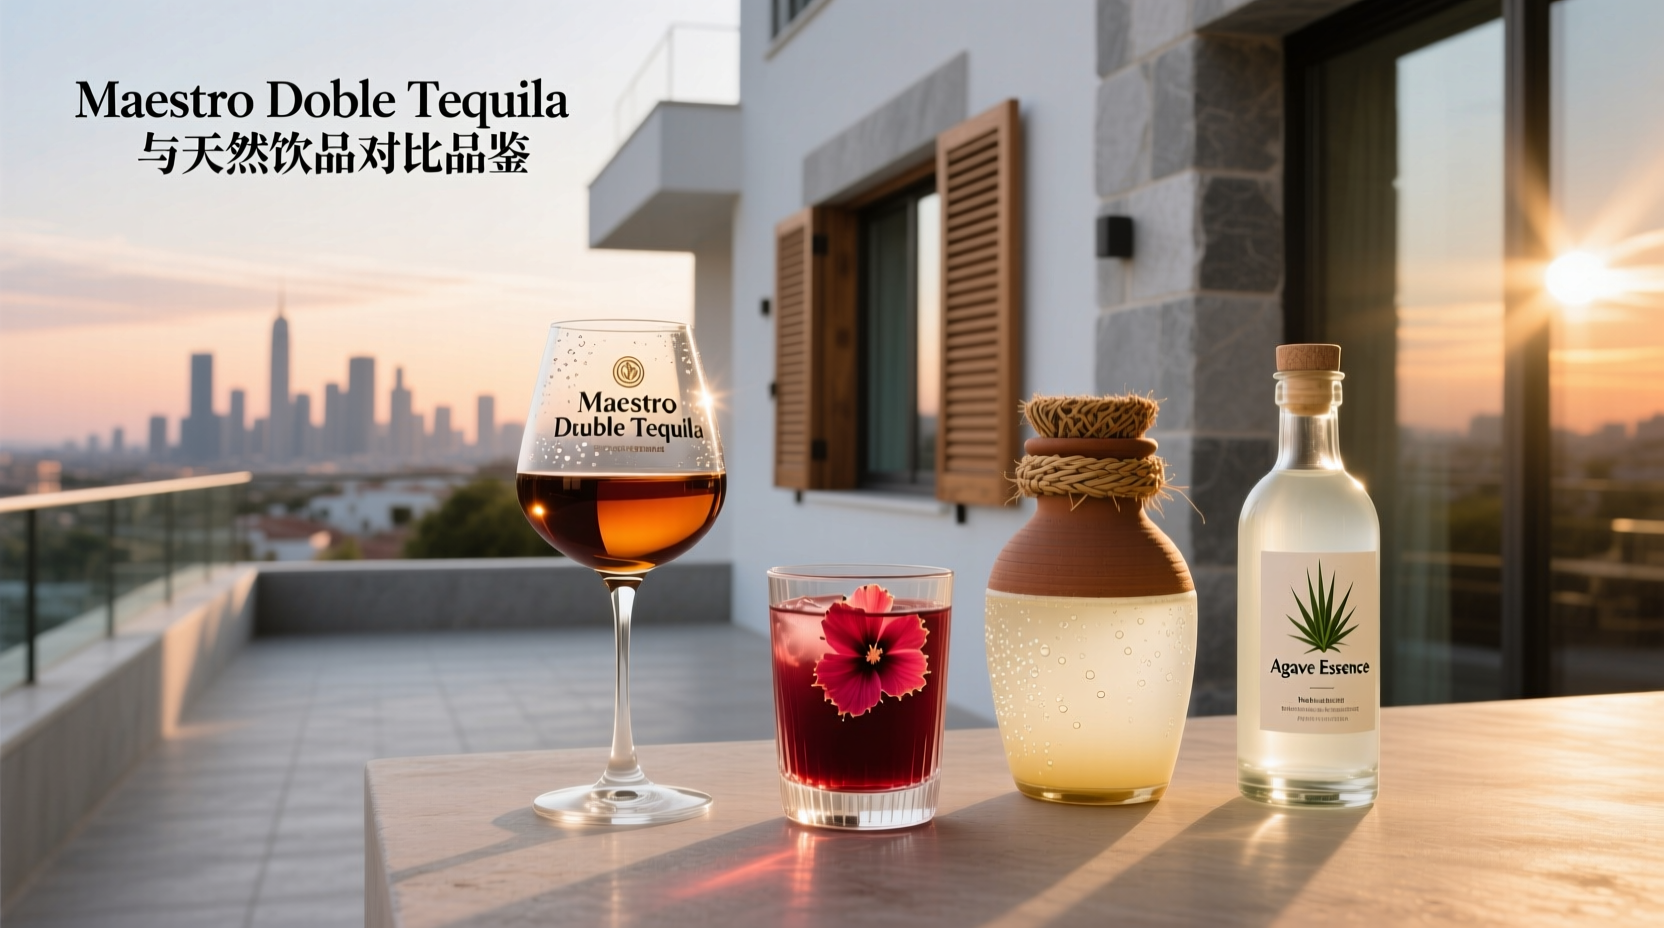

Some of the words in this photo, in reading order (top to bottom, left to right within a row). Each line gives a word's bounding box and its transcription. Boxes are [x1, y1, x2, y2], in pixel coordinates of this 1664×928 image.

[577, 391, 677, 414] Maestro
[630, 417, 704, 443] Tequila
[1270, 658, 1316, 679] Agave
